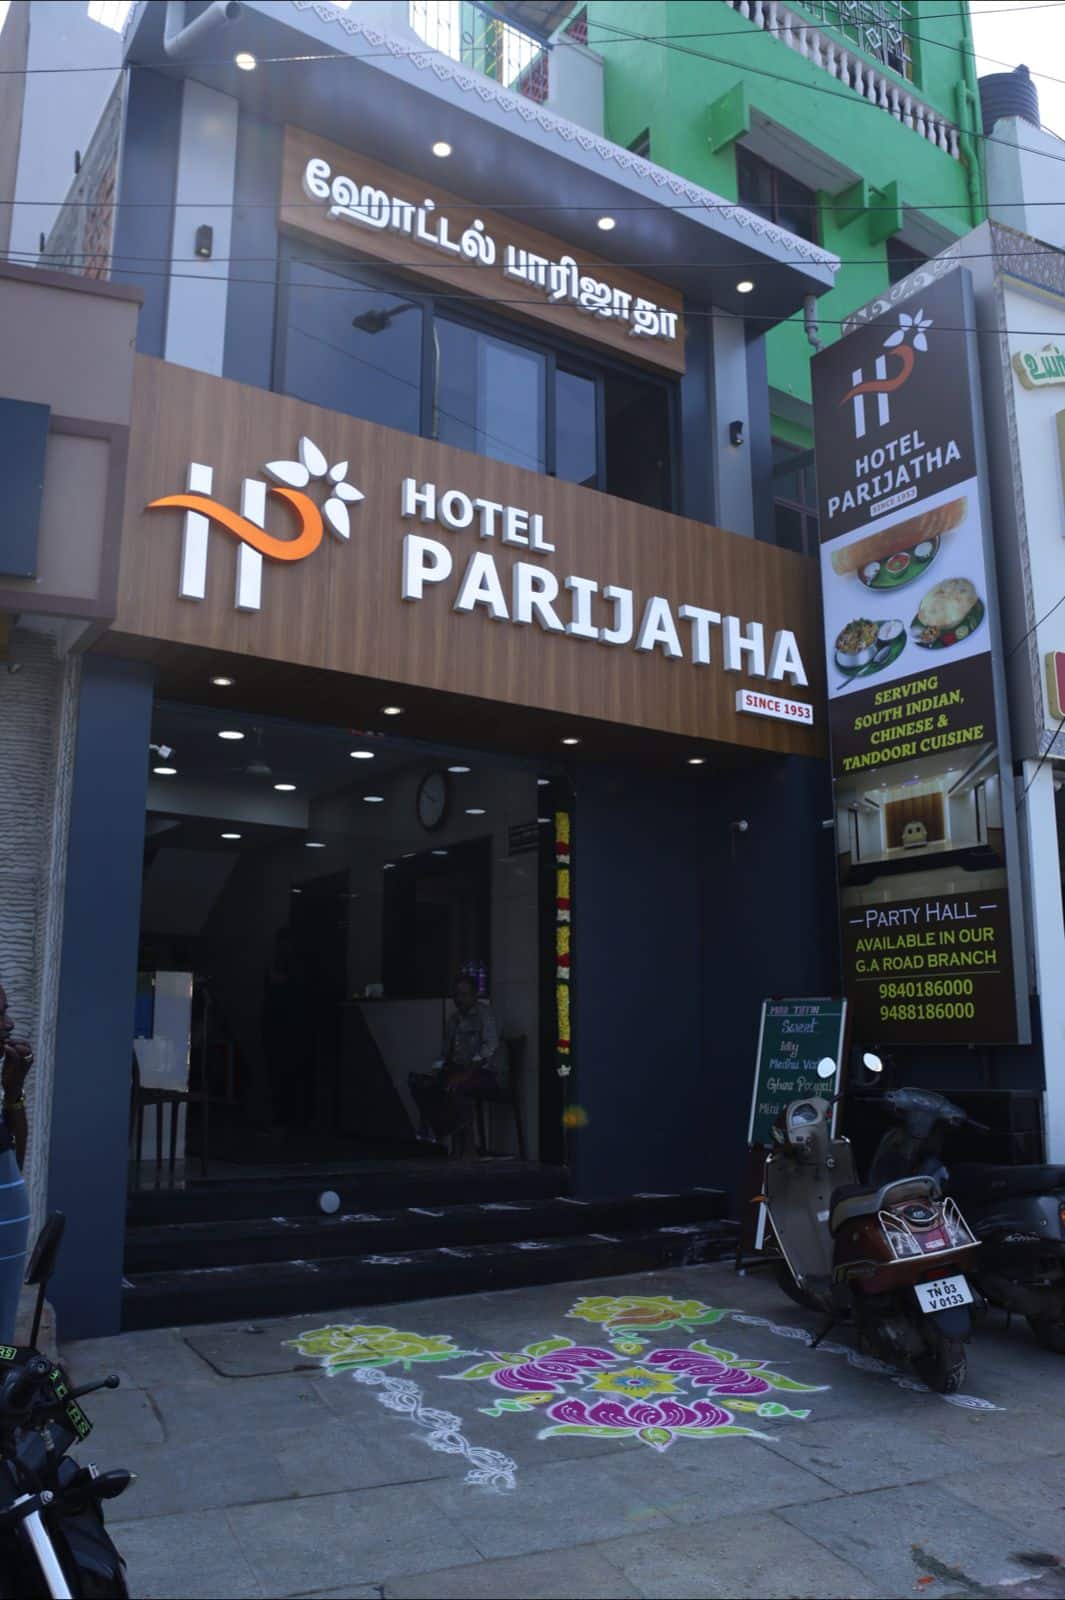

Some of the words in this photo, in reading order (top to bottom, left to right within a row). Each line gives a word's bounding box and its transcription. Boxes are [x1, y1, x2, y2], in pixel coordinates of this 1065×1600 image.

[303, 157, 497, 267] ஹோட்டல்
[504, 244, 679, 340] பாரிஜாதா
[855, 429, 926, 478] HOTEL
[827, 439, 962, 519] PARIJATHA
[401, 477, 556, 555] HOTEL
[871, 498, 895, 514] SINCE
[401, 533, 809, 687] PARIJATHA
[874, 675, 938, 706] SERVING
[745, 694, 781, 713] SINCE
[783, 702, 811, 719] 1953
[854, 705, 902, 731] SOUTH
[906, 688, 965, 716] INDIAN,
[870, 717, 934, 745] CHINESE
[936, 713, 949, 729] &
[842, 741, 917, 771] TANDOORI
[920, 725, 985, 753] CUISINE
[855, 932, 936, 953] AVAILABLE
[939, 931, 955, 945] IN
[959, 927, 995, 943] OUR
[855, 959, 880, 973] G.A
[883, 955, 924, 971] ROAD
[928, 950, 997, 968] BRANCH
[879, 978, 974, 999] 9840186000
[781, 1017, 819, 1033] Sweet
[880, 1002, 975, 1021] 9488186000
[926, 1287, 943, 1298] TN
[943, 1284, 958, 1295] 03
[929, 1300, 938, 1310] V
[939, 1293, 965, 1307] 0133
